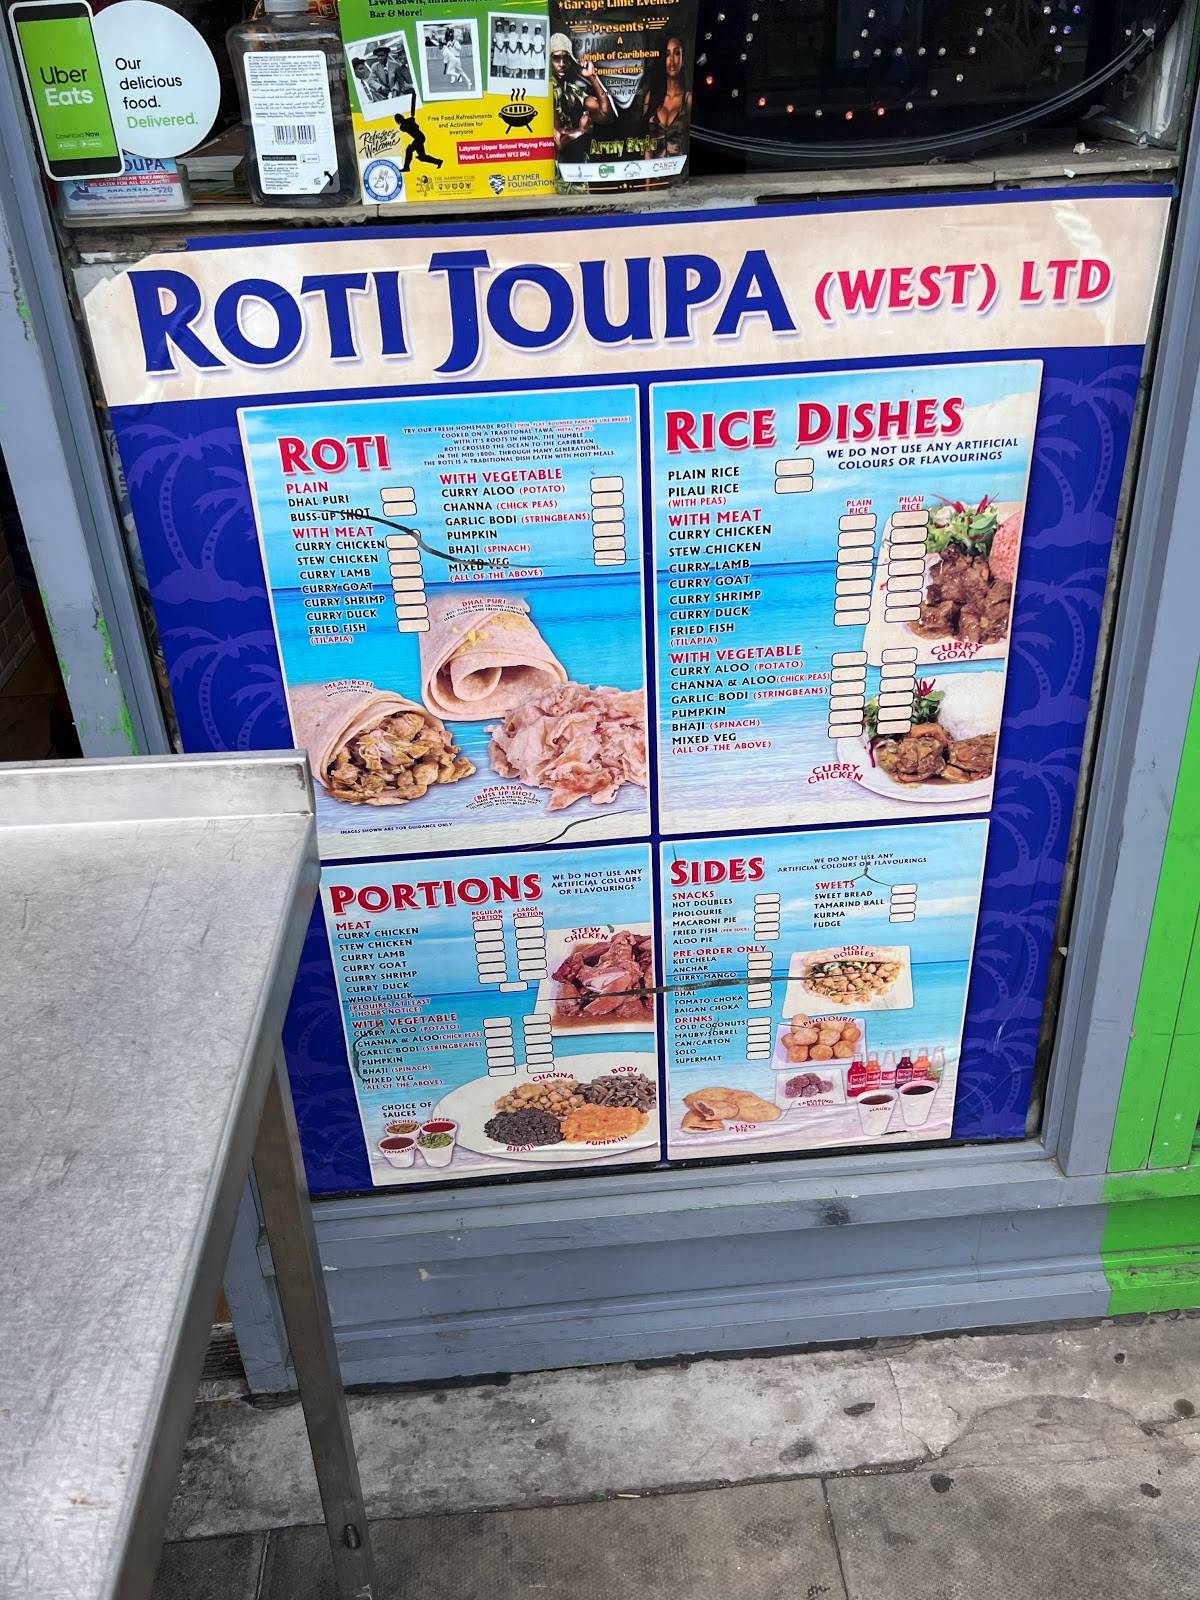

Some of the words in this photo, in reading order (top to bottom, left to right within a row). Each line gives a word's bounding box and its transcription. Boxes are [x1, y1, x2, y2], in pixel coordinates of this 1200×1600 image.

[370, 10, 384, 18] Bar
[388, 9, 395, 17] &
[398, 9, 423, 17] More!
[592, 23, 644, 33] Presents
[618, 50, 659, 59] Caribbean
[115, 58, 141, 70] Our
[40, 67, 87, 84] Uber
[120, 75, 183, 90] delicious
[44, 86, 93, 106] Eats
[123, 96, 161, 110] food.
[127, 112, 198, 128] Delivered.
[814, 263, 996, 321] (WEST)
[1021, 259, 1111, 301] LTD
[126, 269, 408, 373] ROTI
[427, 250, 796, 373] JOUPA
[666, 409, 776, 453] RICE
[798, 397, 964, 443] DISHES
[827, 449, 843, 458] WE
[849, 448, 866, 457] DO
[872, 447, 897, 455] NOT
[901, 445, 921, 453] USE
[926, 443, 951, 452] ANY
[955, 438, 1018, 450] ARTIFICIAL
[277, 435, 390, 474] ROTI
[838, 459, 894, 470] COLOURS
[921, 452, 1002, 464] FLAVOURINGS
[440, 473, 477, 485] WITH
[483, 469, 562, 483] VEGETABLE
[668, 470, 706, 480] PLAIN
[712, 467, 740, 477] RICE
[286, 482, 328, 494] PLAIN
[442, 488, 479, 497] CURRY
[483, 487, 515, 495] ALOO
[519, 485, 565, 495] (POTATO)
[668, 486, 705, 497] PILAU
[711, 484, 739, 494] RICE
[288, 498, 318, 507] DHAL
[323, 495, 349, 504] PURI
[443, 502, 492, 512] CHANNA
[497, 502, 528, 510] (CHICK
[532, 500, 557, 509] PEAS)
[668, 499, 696, 508] (WITH
[700, 497, 726, 506] PEAS)
[291, 512, 336, 522] BUSS-UP
[445, 516, 485, 526] GARLIC
[490, 515, 516, 524] BODI
[521, 513, 590, 524] (STRINGBEANS)
[669, 514, 710, 527] WITH
[717, 509, 762, 523] MEAT
[292, 528, 331, 538] WITH
[335, 527, 374, 537] MEAT
[447, 530, 497, 540] PUMPKIN
[669, 530, 710, 540] CURRY
[716, 525, 771, 537] CHICKEN
[295, 542, 331, 551] CURRY
[336, 541, 385, 549] CHICKEN
[449, 546, 479, 555] BHAJI
[484, 544, 530, 553] (SPINACH)
[669, 547, 700, 557] STEW
[706, 542, 761, 554] CHICKEN
[298, 556, 325, 565] STEW
[329, 555, 378, 564] CHICKEN
[669, 563, 711, 573] CURRY
[716, 560, 750, 570] LAMB
[300, 570, 335, 580] CURRY
[341, 568, 371, 578] LAMB
[302, 584, 339, 593] CURRY
[343, 582, 373, 591] GOAT
[670, 578, 710, 588] CURRY
[716, 575, 750, 585] GOAT
[304, 598, 340, 608] CURRY
[345, 596, 385, 606] SHRIMP
[670, 594, 710, 604] CURRY
[716, 591, 761, 601] SHRIMP
[306, 612, 342, 621] CURRY
[347, 610, 377, 619] DUCK
[670, 610, 710, 620] CURRY
[716, 607, 749, 617] DUCK
[309, 625, 339, 635] FRIED
[343, 624, 366, 632] FISH
[671, 625, 704, 636] FRIED
[710, 623, 734, 632] FISH
[310, 636, 352, 645] (TILAPIA)
[671, 637, 718, 647] (TILAPIA)
[670, 652, 709, 664] WITH
[717, 645, 801, 660] VEGETABLE
[931, 642, 983, 655] CURRY
[938, 651, 975, 661] GOAT
[671, 666, 710, 676] CURRY
[715, 663, 749, 673] ALOO
[754, 661, 803, 671] (POTATO)
[672, 693, 713, 704] GARLIC
[719, 692, 748, 701] BODI
[753, 687, 828, 699] (STRINGBEANS)
[672, 707, 726, 717] PUMPKIN
[672, 722, 705, 731] BHAJI
[710, 719, 760, 730] (SPINACH)
[672, 735, 709, 744] MIXED
[713, 733, 737, 741] VEG
[670, 857, 765, 885] SIDES
[816, 880, 854, 890] SWEETS
[329, 874, 540, 915] PORTIONS
[673, 891, 714, 900] SNACKS
[694, 898, 733, 907] DOUBLES
[673, 909, 722, 917] PHOLOURIE
[336, 921, 371, 931] MEAT
[338, 932, 370, 940] CURRY
[375, 928, 419, 937] CHICKEN
[340, 943, 364, 951] STEW
[368, 939, 412, 948] CHICKEN
[673, 947, 733, 957] PRE-ORDER
[737, 945, 766, 953] ONLY
[834, 951, 875, 959] DOUBLES
[675, 1016, 712, 1024] DRINKS
[675, 1056, 722, 1064] SUPERMALT
[610, 1066, 637, 1075] BODI
[532, 1072, 575, 1083] CHANNA
[585, 1135, 628, 1146] PUMPKIN
[506, 1143, 535, 1152] BHAJI
